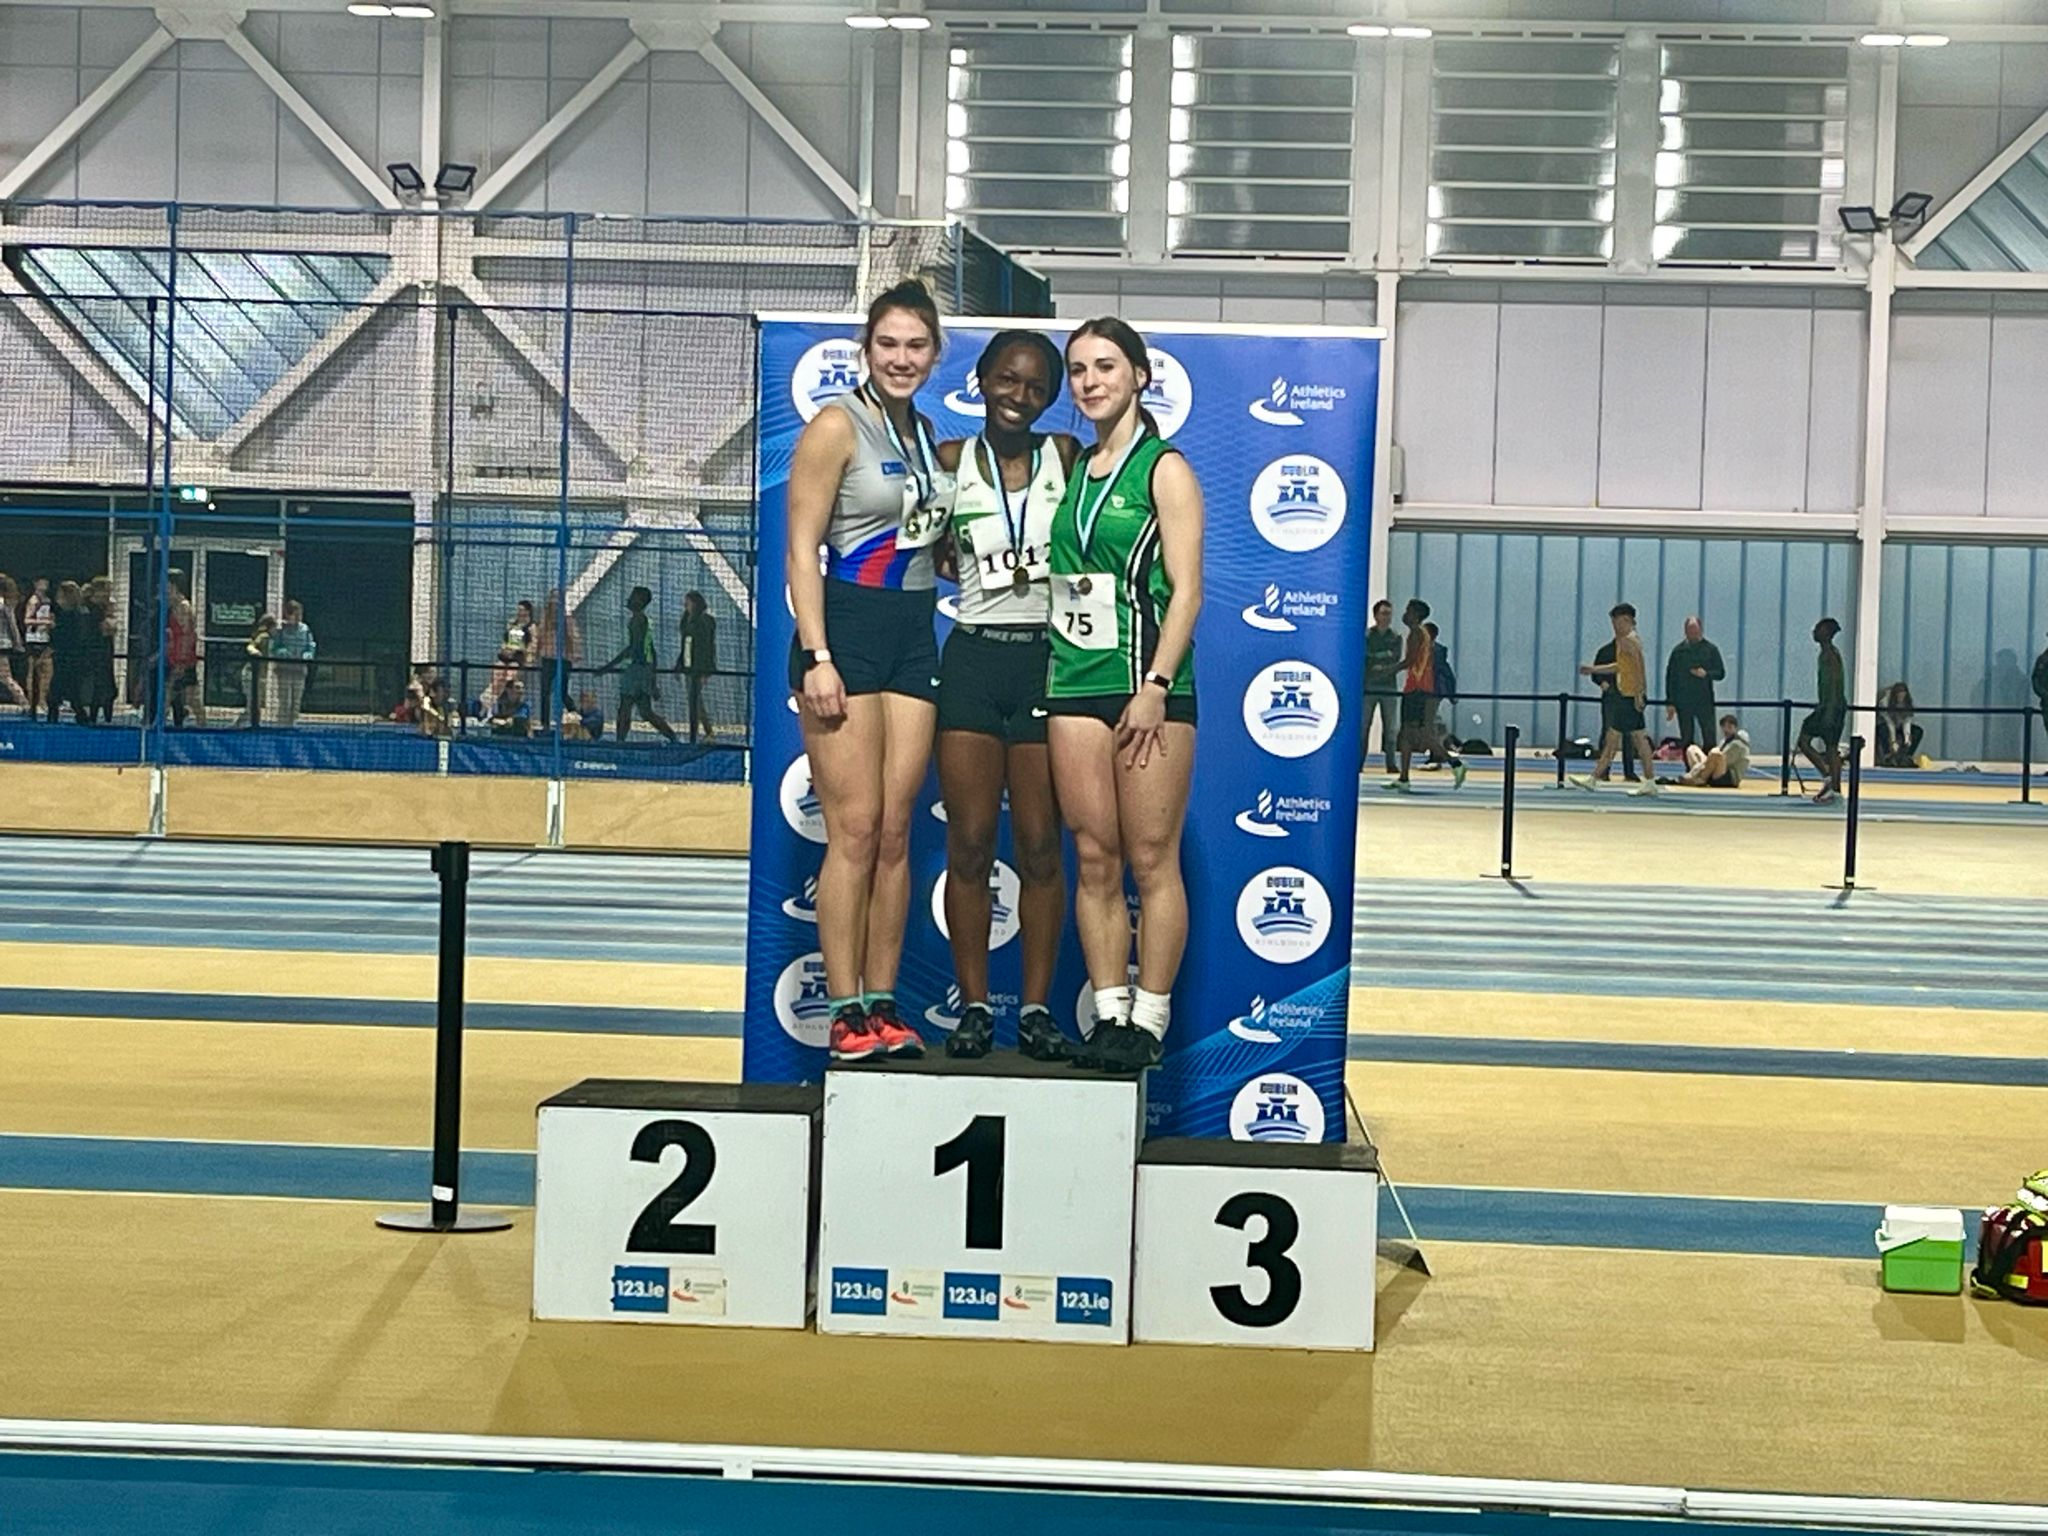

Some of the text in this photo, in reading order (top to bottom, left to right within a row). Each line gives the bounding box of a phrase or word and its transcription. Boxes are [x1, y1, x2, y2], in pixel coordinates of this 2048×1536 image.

[1290, 384, 1347, 399] Athletics
[1290, 399, 1334, 411] Ireland
[1282, 590, 1339, 605] Athletics
[1282, 603, 1326, 617] Ireland
[1064, 611, 1093, 636] 75
[1275, 796, 1332, 811] Athletics
[1275, 808, 1319, 823] Ireland
[1266, 876, 1305, 889] DUBLIN
[1268, 1002, 1325, 1018] Athletics
[1268, 1015, 1312, 1028] Ireland
[625, 1118, 717, 1256] 2
[933, 1114, 1006, 1250] 1
[1209, 1191, 1302, 1328] 3
[616, 1279, 665, 1298] 123.ie
[834, 1281, 883, 1301] 123.ie
[948, 1285, 998, 1306] 123.ie
[1060, 1290, 1110, 1311] 123.ie
